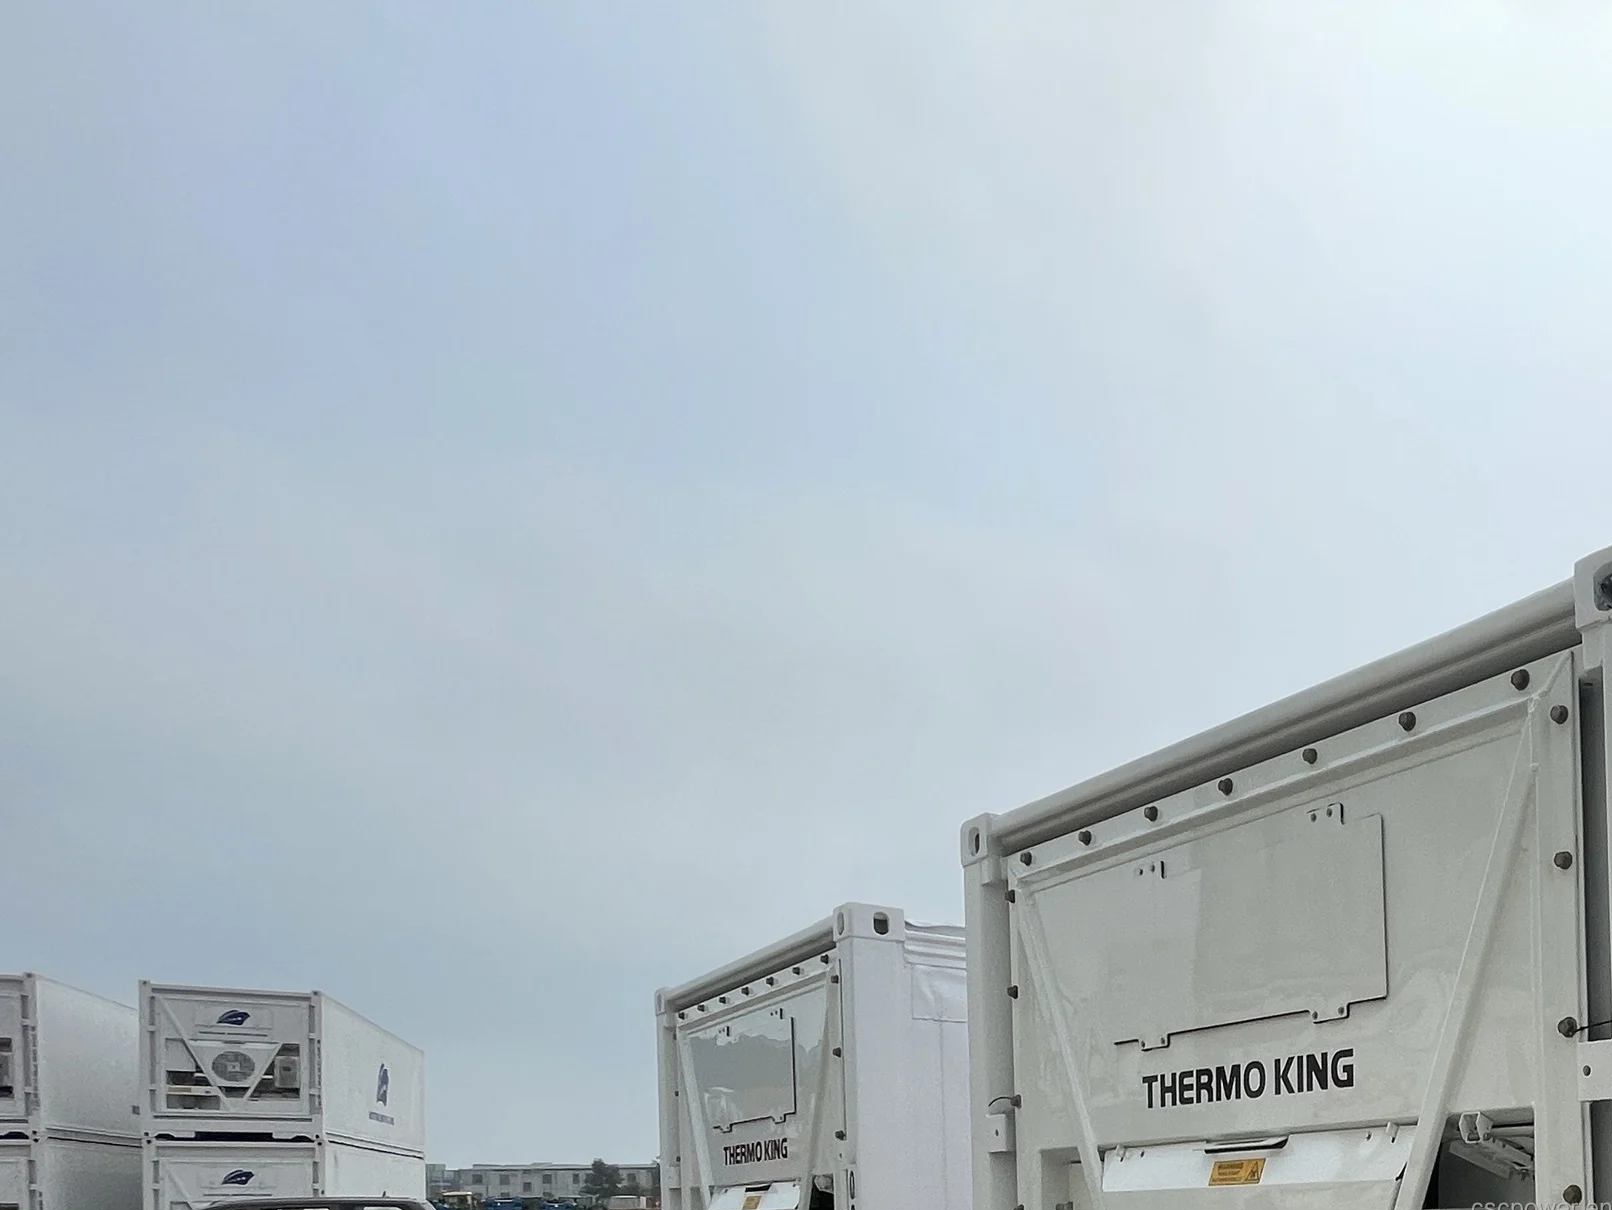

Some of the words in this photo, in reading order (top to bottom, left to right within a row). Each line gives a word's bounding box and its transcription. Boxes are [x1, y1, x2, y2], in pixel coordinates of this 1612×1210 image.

[1142, 1061, 1266, 1108] THERMO
[1274, 1048, 1354, 1096] KING
[723, 1141, 762, 1165] THERMO
[764, 1138, 788, 1160] KING
